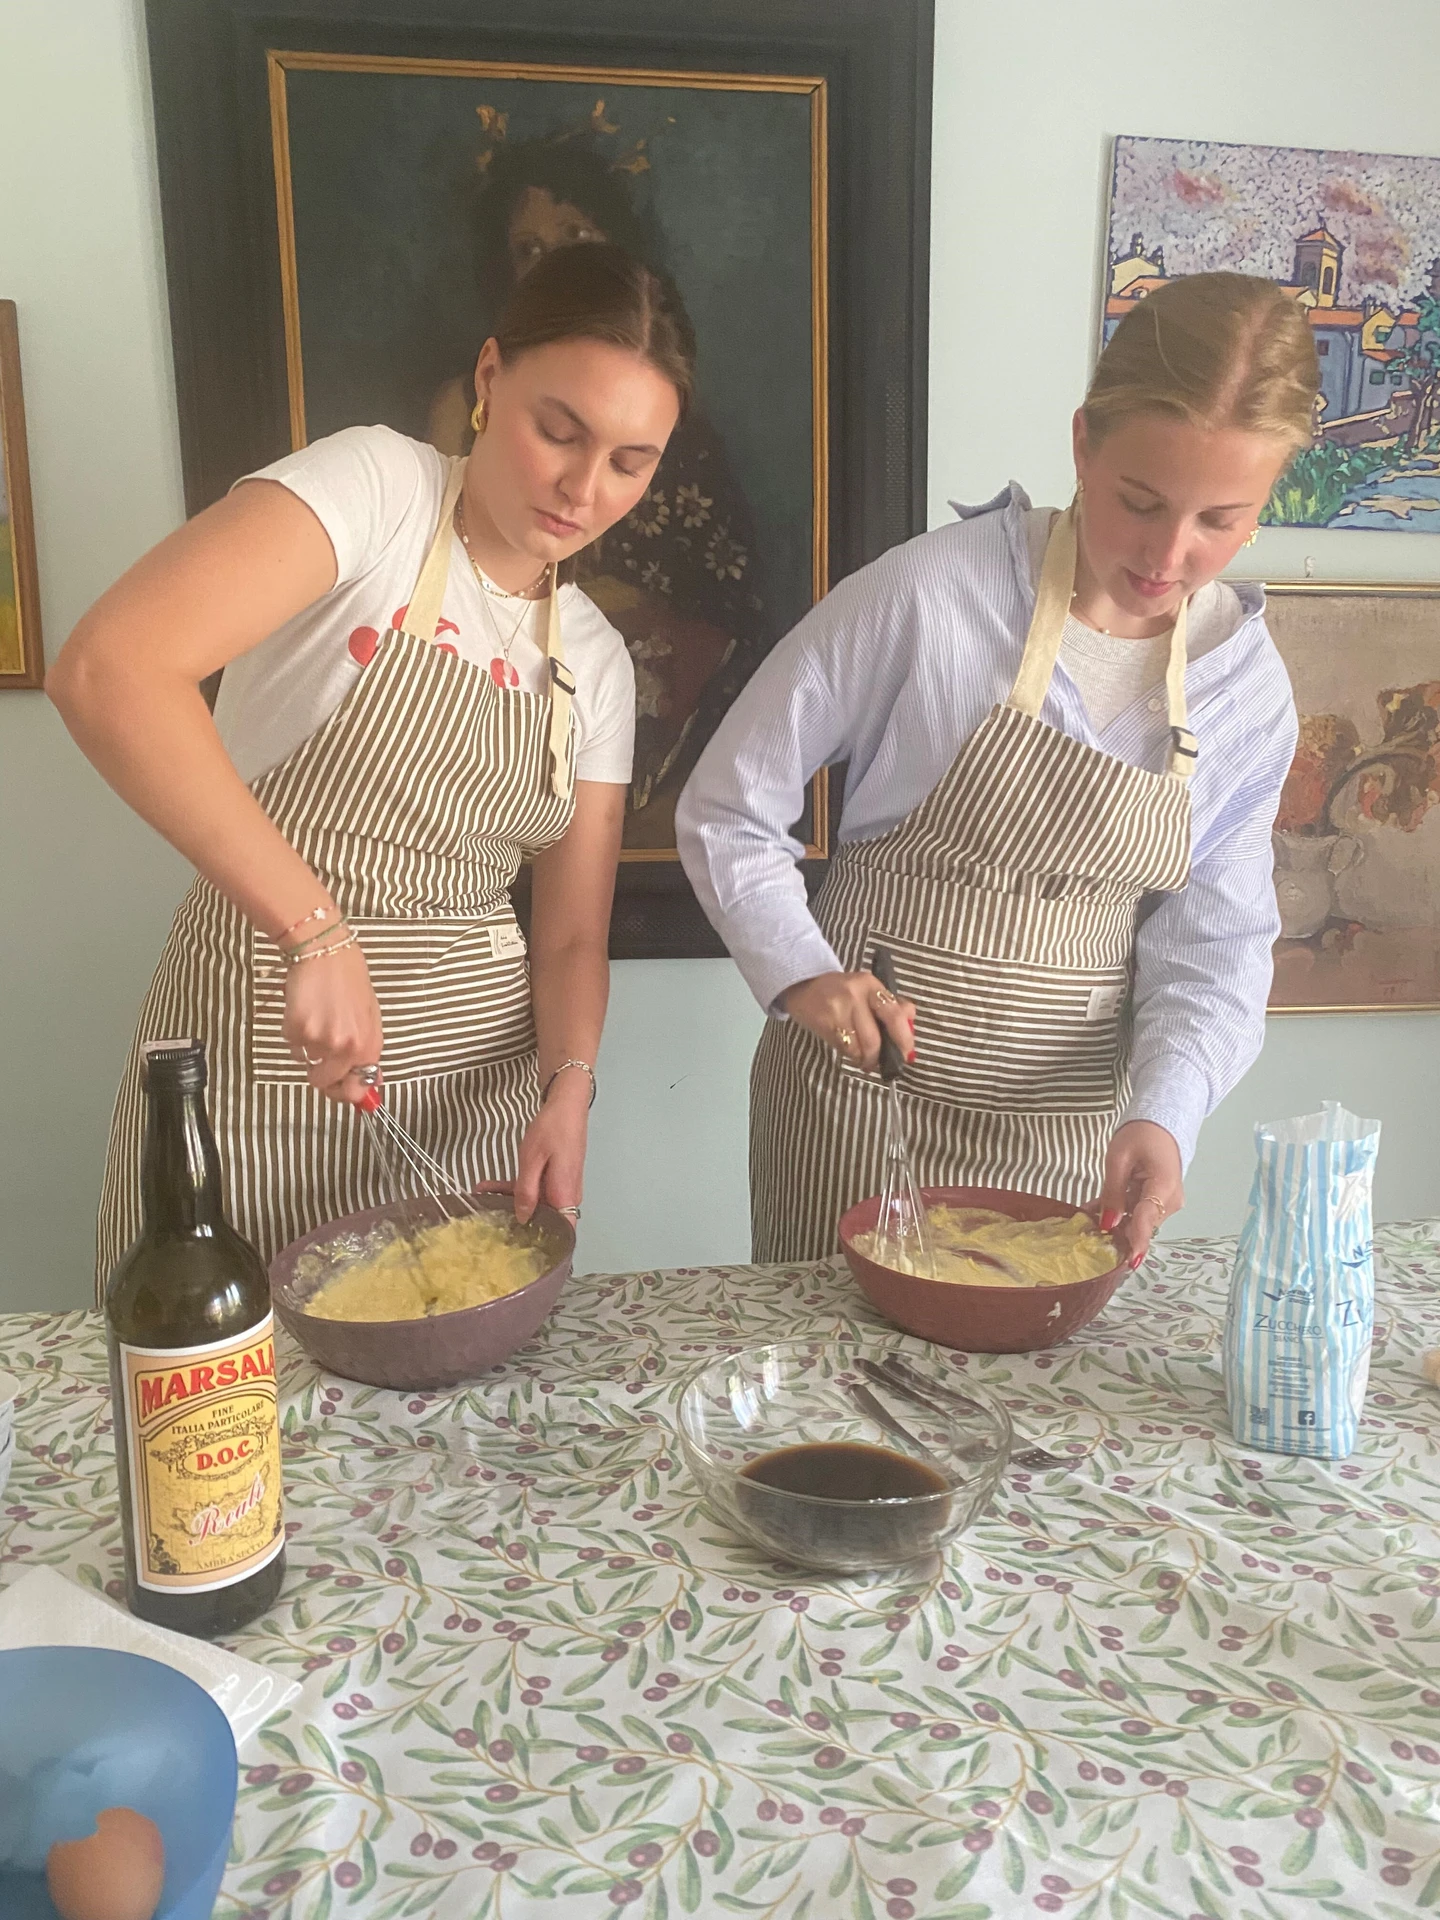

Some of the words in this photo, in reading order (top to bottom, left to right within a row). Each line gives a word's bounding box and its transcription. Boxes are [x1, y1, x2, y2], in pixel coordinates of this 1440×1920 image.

[1253, 1313, 1322, 1336] ZUCCHERO
[140, 1343, 275, 1419] MARSALA
[172, 1423, 205, 1434] ITALIA
[208, 1400, 265, 1430] PARTICOLARE
[212, 1404, 235, 1419] FINE
[196, 1440, 254, 1471] D.O.C.
[197, 1555, 235, 1570] AMBRA
[236, 1540, 265, 1559] SECCO
